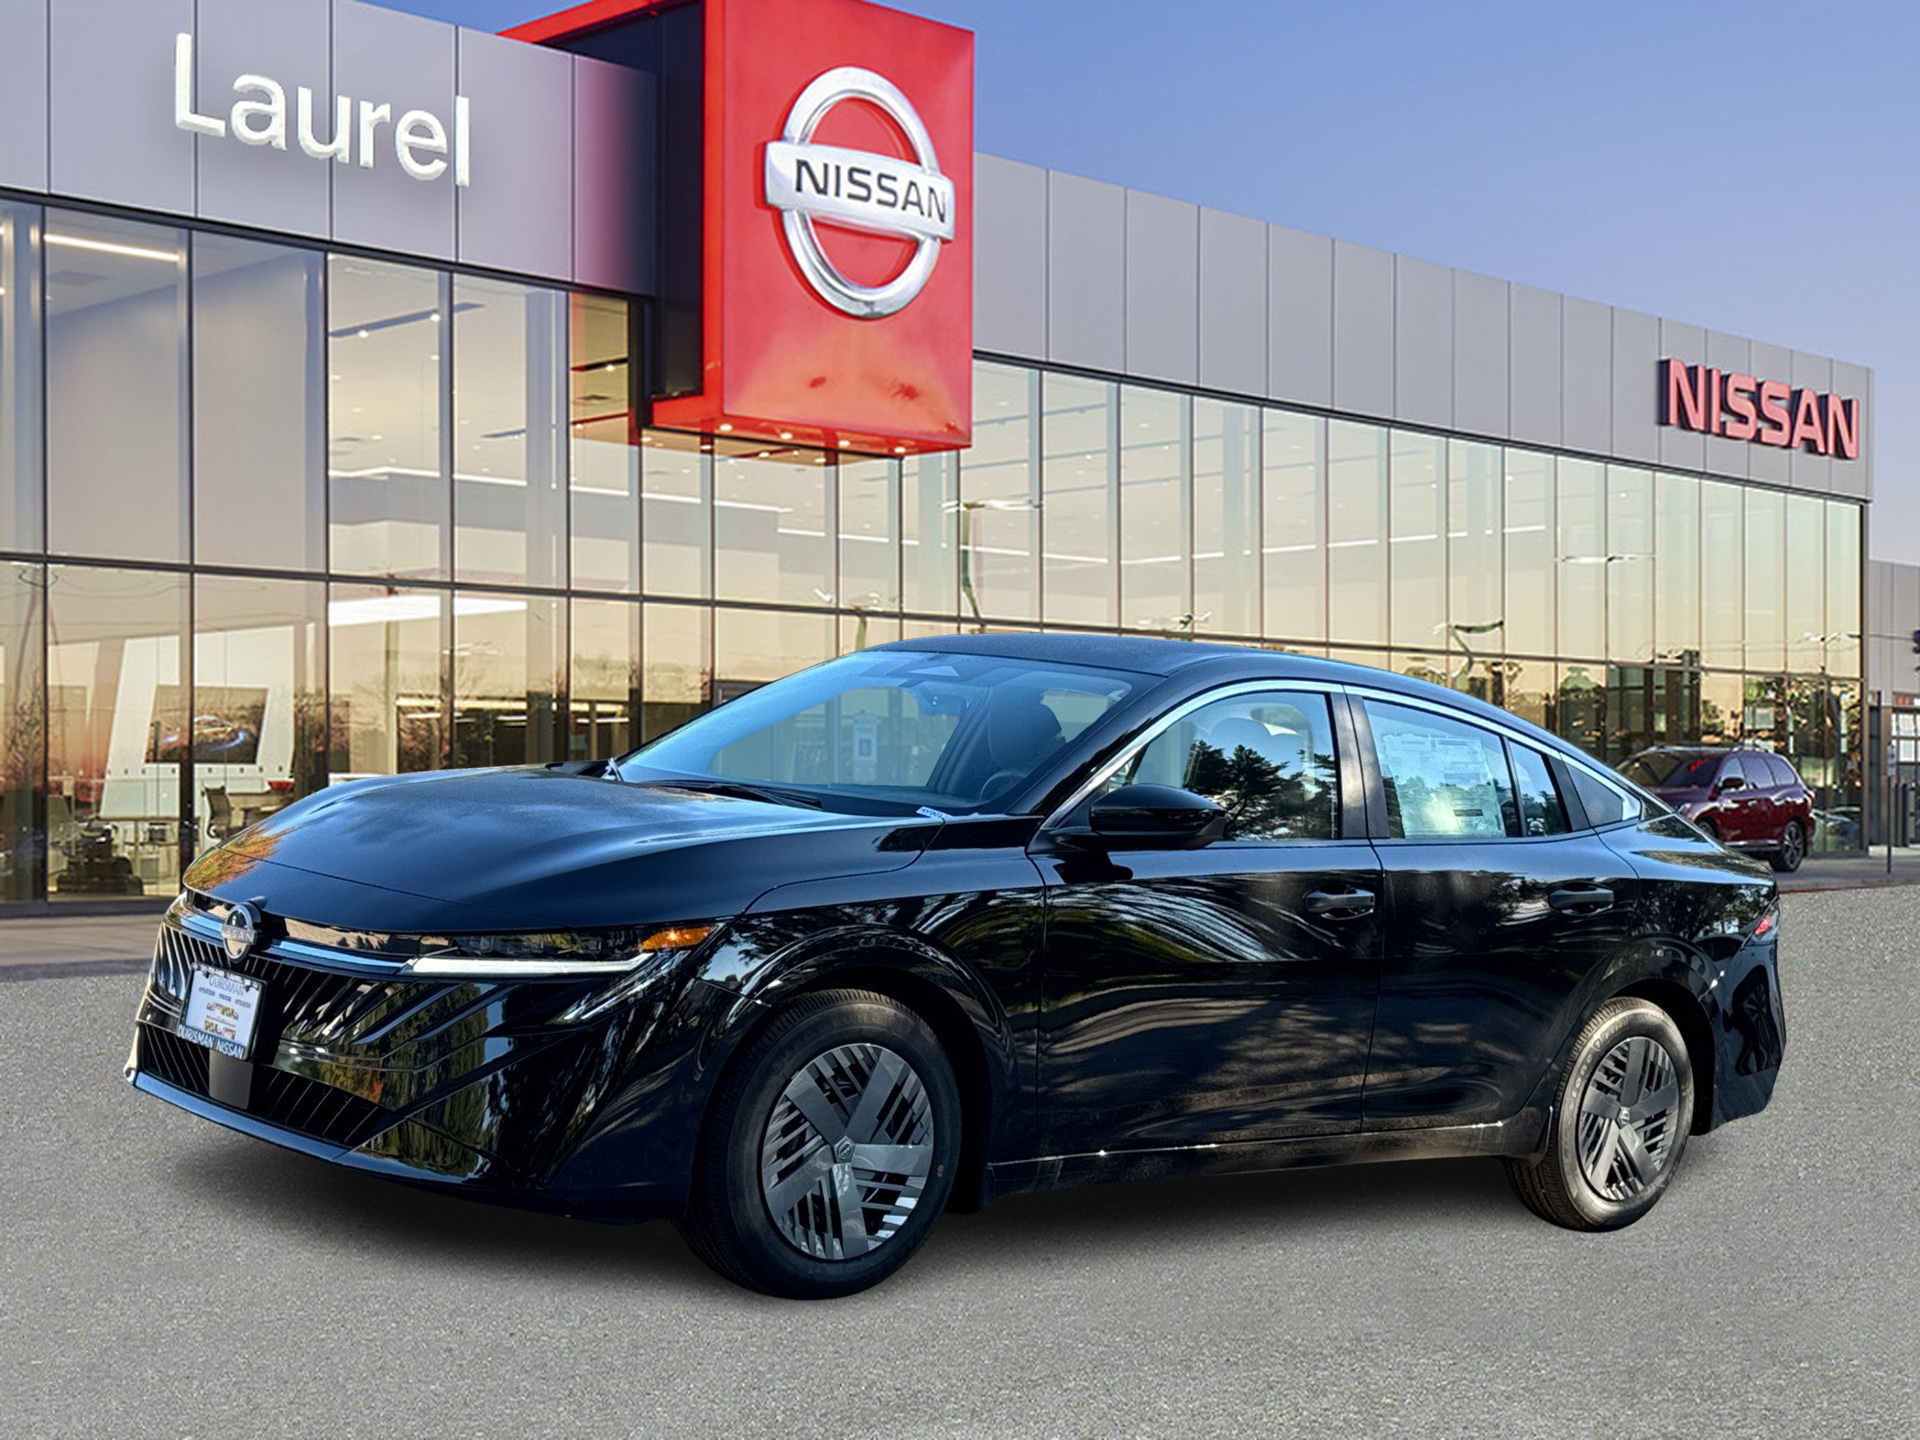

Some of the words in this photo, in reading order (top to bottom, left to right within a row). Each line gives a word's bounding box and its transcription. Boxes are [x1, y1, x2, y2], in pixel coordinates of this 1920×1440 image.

[175, 33, 469, 187] Laurel
[795, 159, 946, 223] NISSAN
[1657, 358, 1860, 459] NISSAN
[177, 1024, 215, 1049] OURISMAN
[216, 1039, 244, 1060] NISSAN
